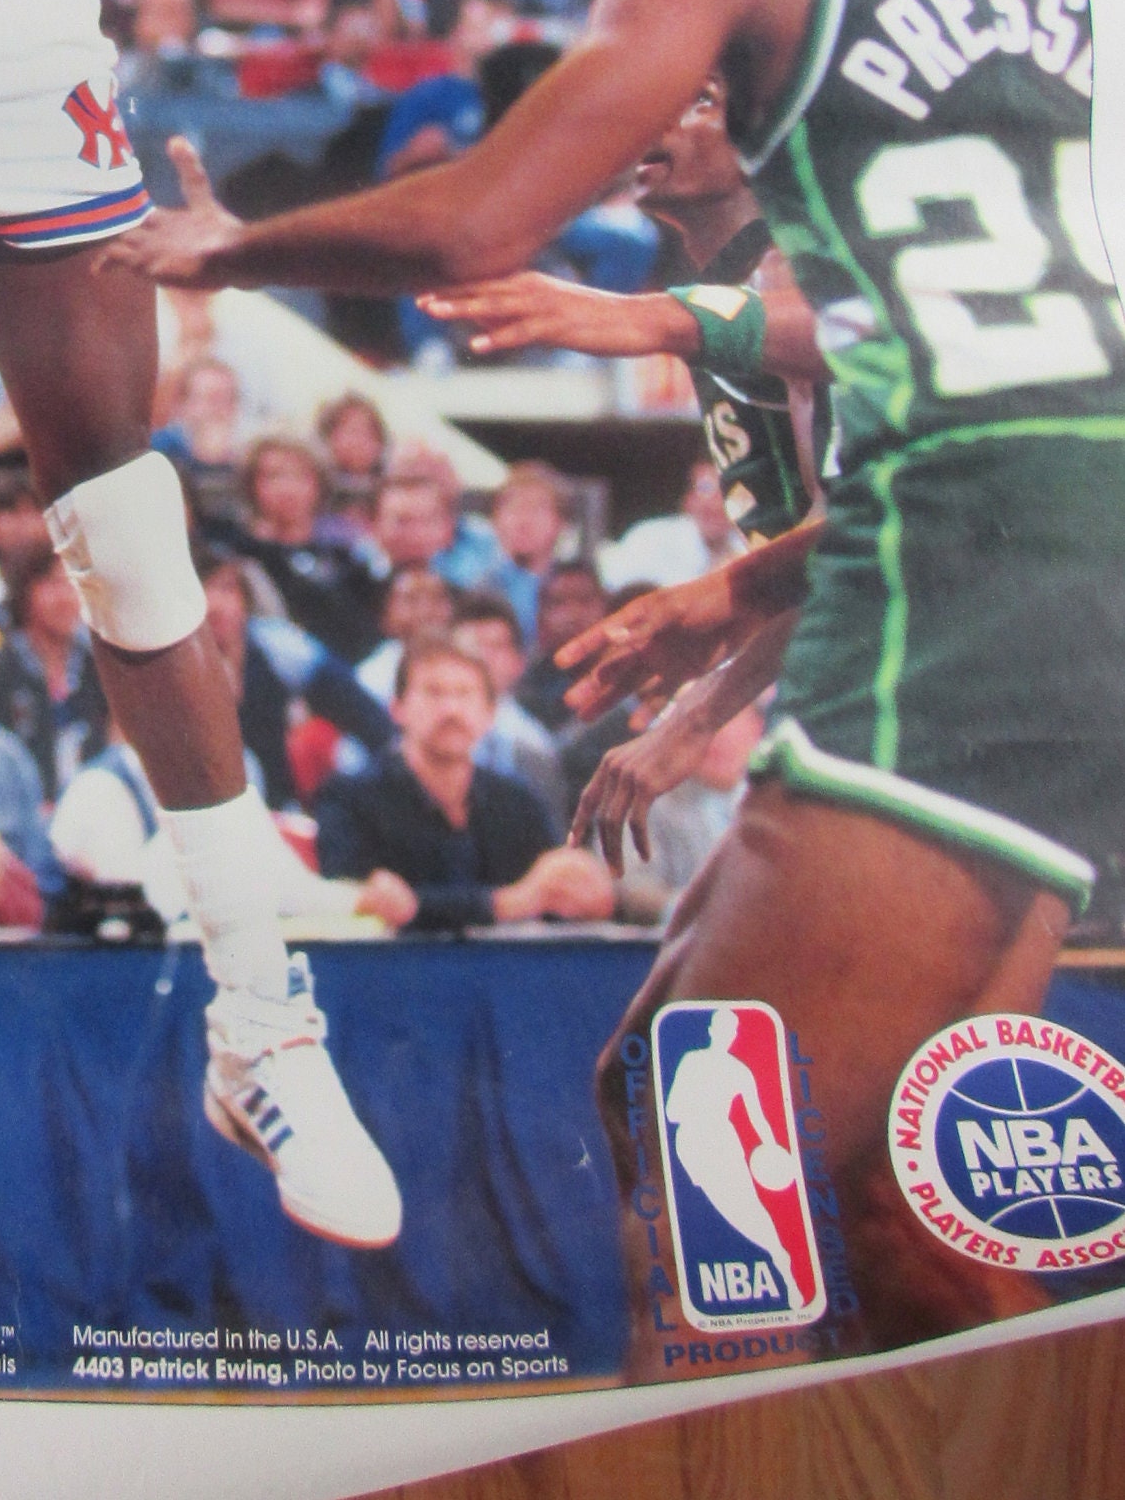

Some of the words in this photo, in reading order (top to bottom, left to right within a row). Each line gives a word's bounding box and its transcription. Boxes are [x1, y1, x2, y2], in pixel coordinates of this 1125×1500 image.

[896, 1024, 987, 1151] NATIONAL
[956, 1117, 1118, 1170] NBA
[619, 1033, 678, 1333] OFFICIAL
[969, 1163, 1124, 1198] PLAYERS
[909, 1181, 1021, 1266] PLAYERS
[697, 1259, 781, 1303] NBA
[73, 1324, 219, 1349] Manufactured
[225, 1328, 243, 1349] in
[248, 1328, 281, 1350] the
[286, 1328, 344, 1351] U.S.A.
[364, 1329, 389, 1351] All
[395, 1330, 452, 1355] rights
[457, 1329, 549, 1351] reserved
[72, 1356, 125, 1379] 4403
[130, 1357, 210, 1380] Patrick
[215, 1358, 289, 1385] Ewing,
[295, 1359, 356, 1381] Photo
[362, 1359, 390, 1384] by
[396, 1358, 461, 1379] Focus
[466, 1361, 495, 1378] on
[500, 1355, 569, 1379] Sports
